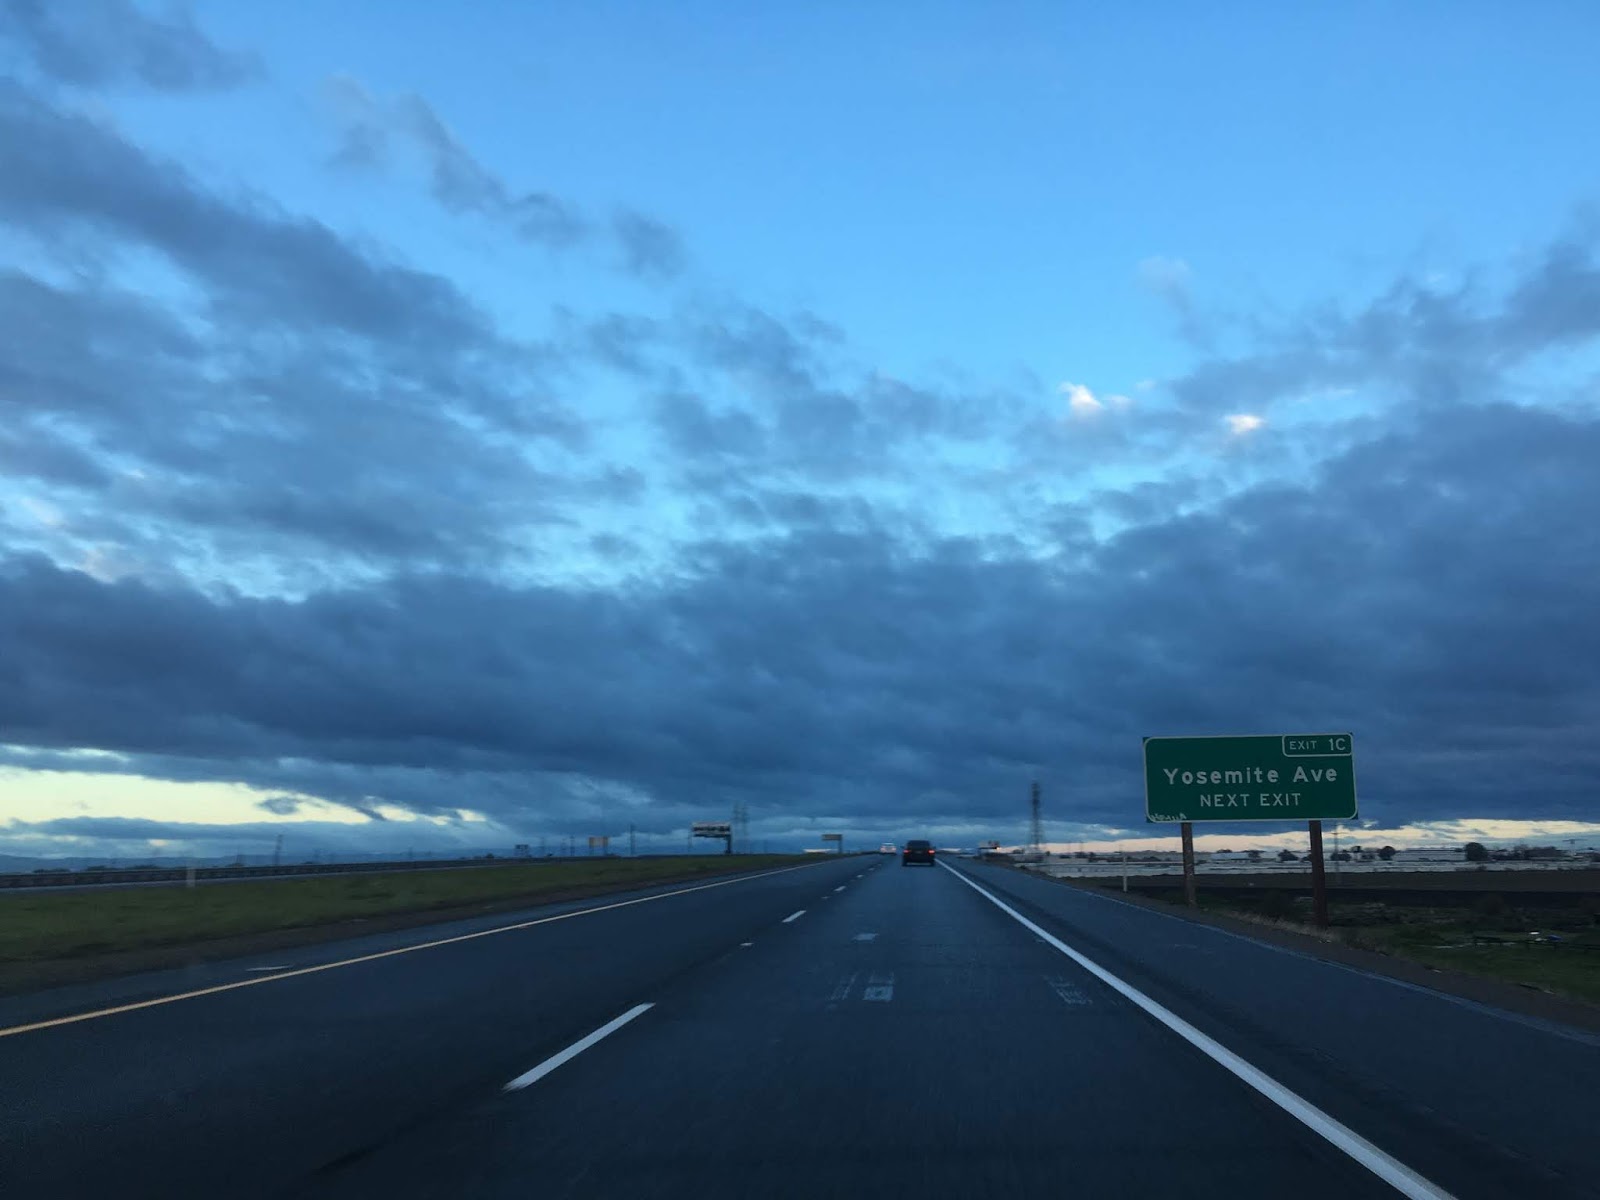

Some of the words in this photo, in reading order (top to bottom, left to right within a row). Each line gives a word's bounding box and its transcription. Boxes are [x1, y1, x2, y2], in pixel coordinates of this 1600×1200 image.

[1289, 740, 1317, 750] EXIT
[1328, 738, 1346, 751] 1C
[1163, 766, 1280, 784] Yosemite
[1292, 766, 1338, 783] Ave
[1200, 793, 1250, 807] NEXT
[1260, 792, 1301, 806] EXIT
